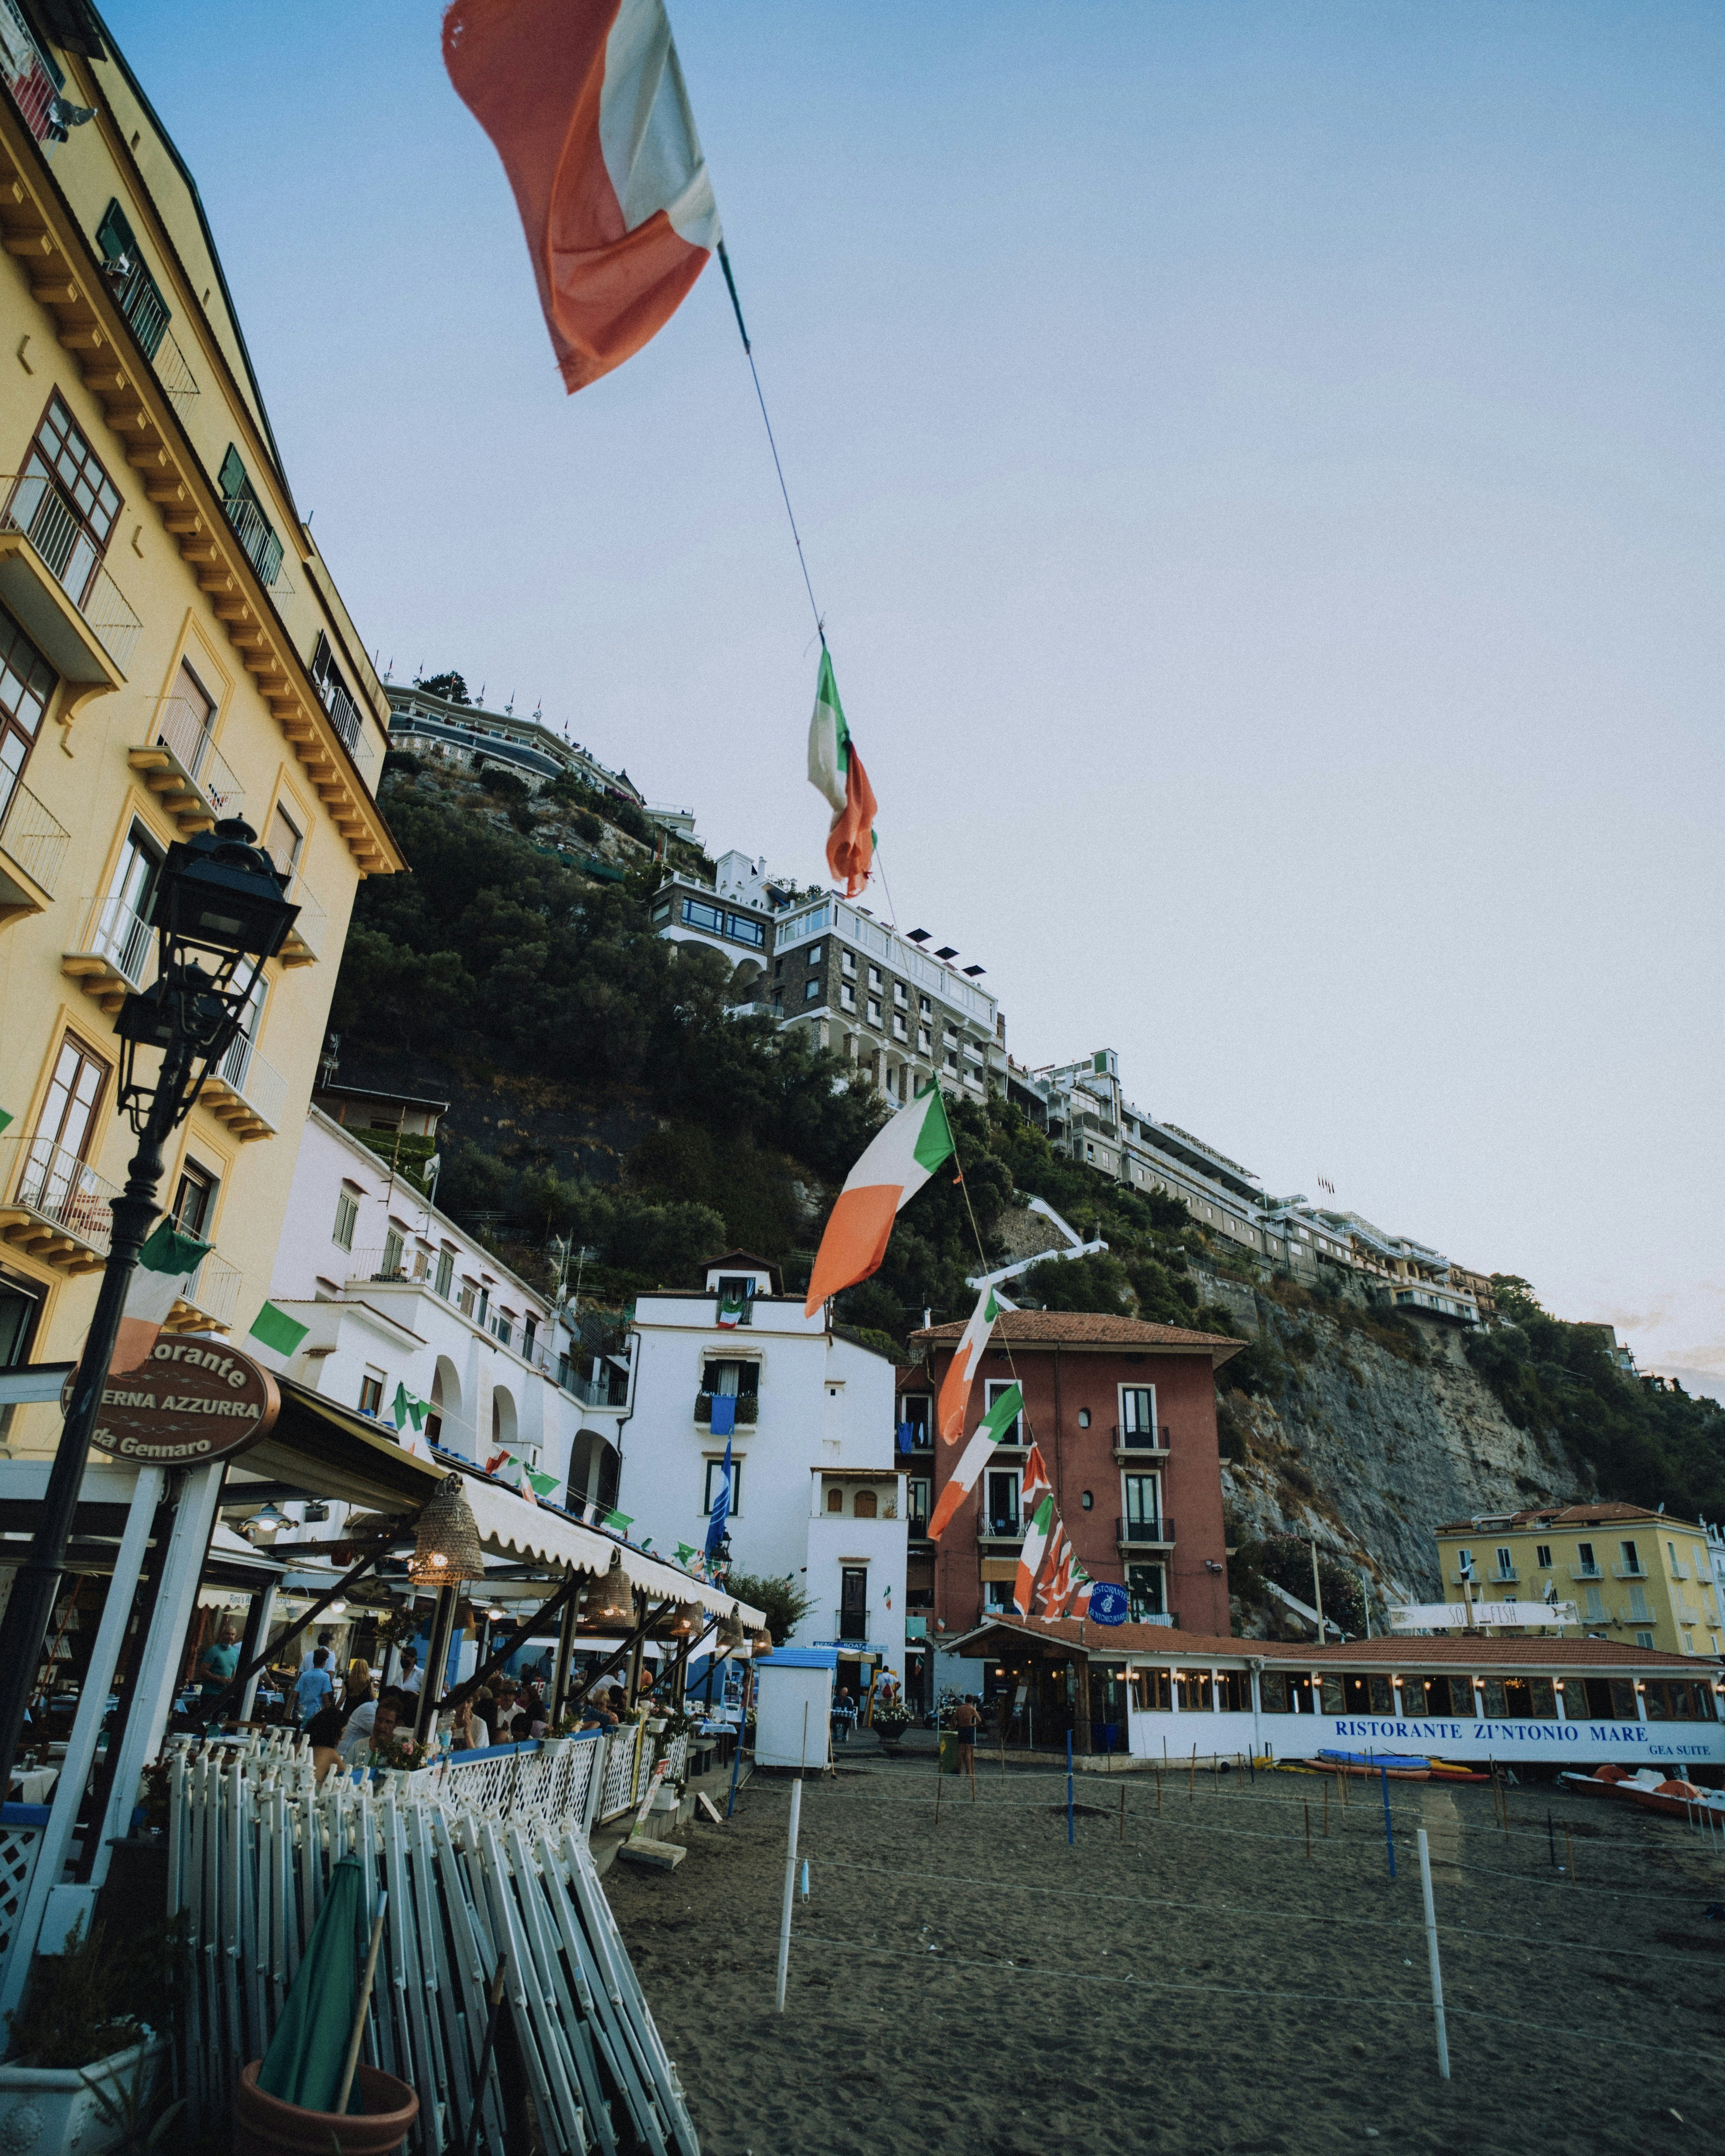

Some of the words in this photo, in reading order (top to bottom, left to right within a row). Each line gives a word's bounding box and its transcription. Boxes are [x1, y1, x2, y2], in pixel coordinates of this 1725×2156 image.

[147, 1344, 247, 1388] orante
[64, 1386, 157, 1409] TERNA
[161, 1395, 260, 1419] AZZURRA
[92, 1426, 117, 1449] da
[120, 1436, 212, 1457] Gennaro
[1490, 1605, 1517, 1624] FISH
[1335, 1721, 1462, 1739] RISTORANTE
[1474, 1724, 1578, 1741] ZI'NTONIO
[1590, 1727, 1648, 1742] MARE
[1649, 1745, 1673, 1755] GEA
[1676, 1746, 1711, 1755] SUITE
